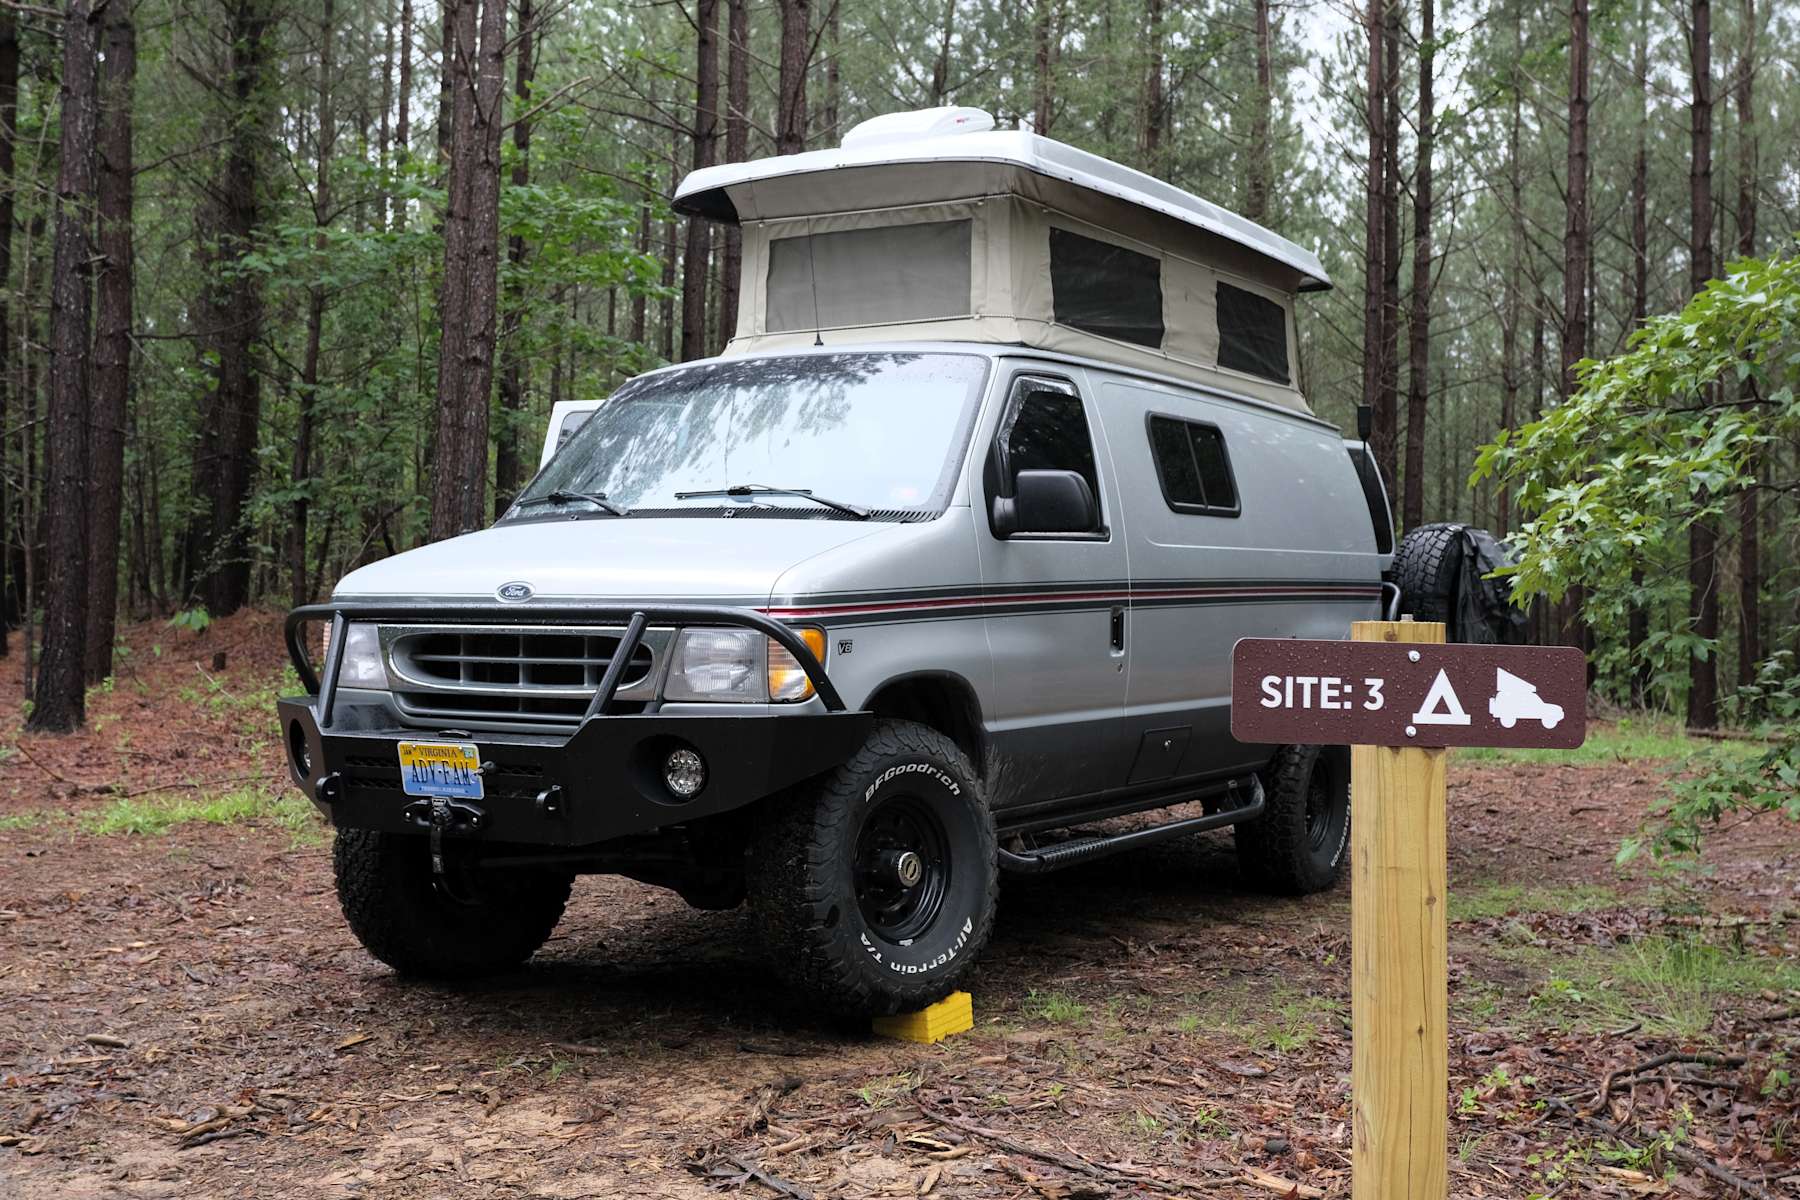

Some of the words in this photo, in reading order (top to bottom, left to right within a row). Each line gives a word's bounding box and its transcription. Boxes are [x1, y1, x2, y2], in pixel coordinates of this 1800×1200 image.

[838, 641, 853, 656] V8
[1260, 675, 1352, 710] SITE:
[1363, 678, 1384, 711] 3
[419, 747, 458, 758] VIRGINIA
[865, 763, 961, 803] BFGoodrich
[860, 932, 882, 963] T/A
[890, 916, 973, 975] All-Terrain
